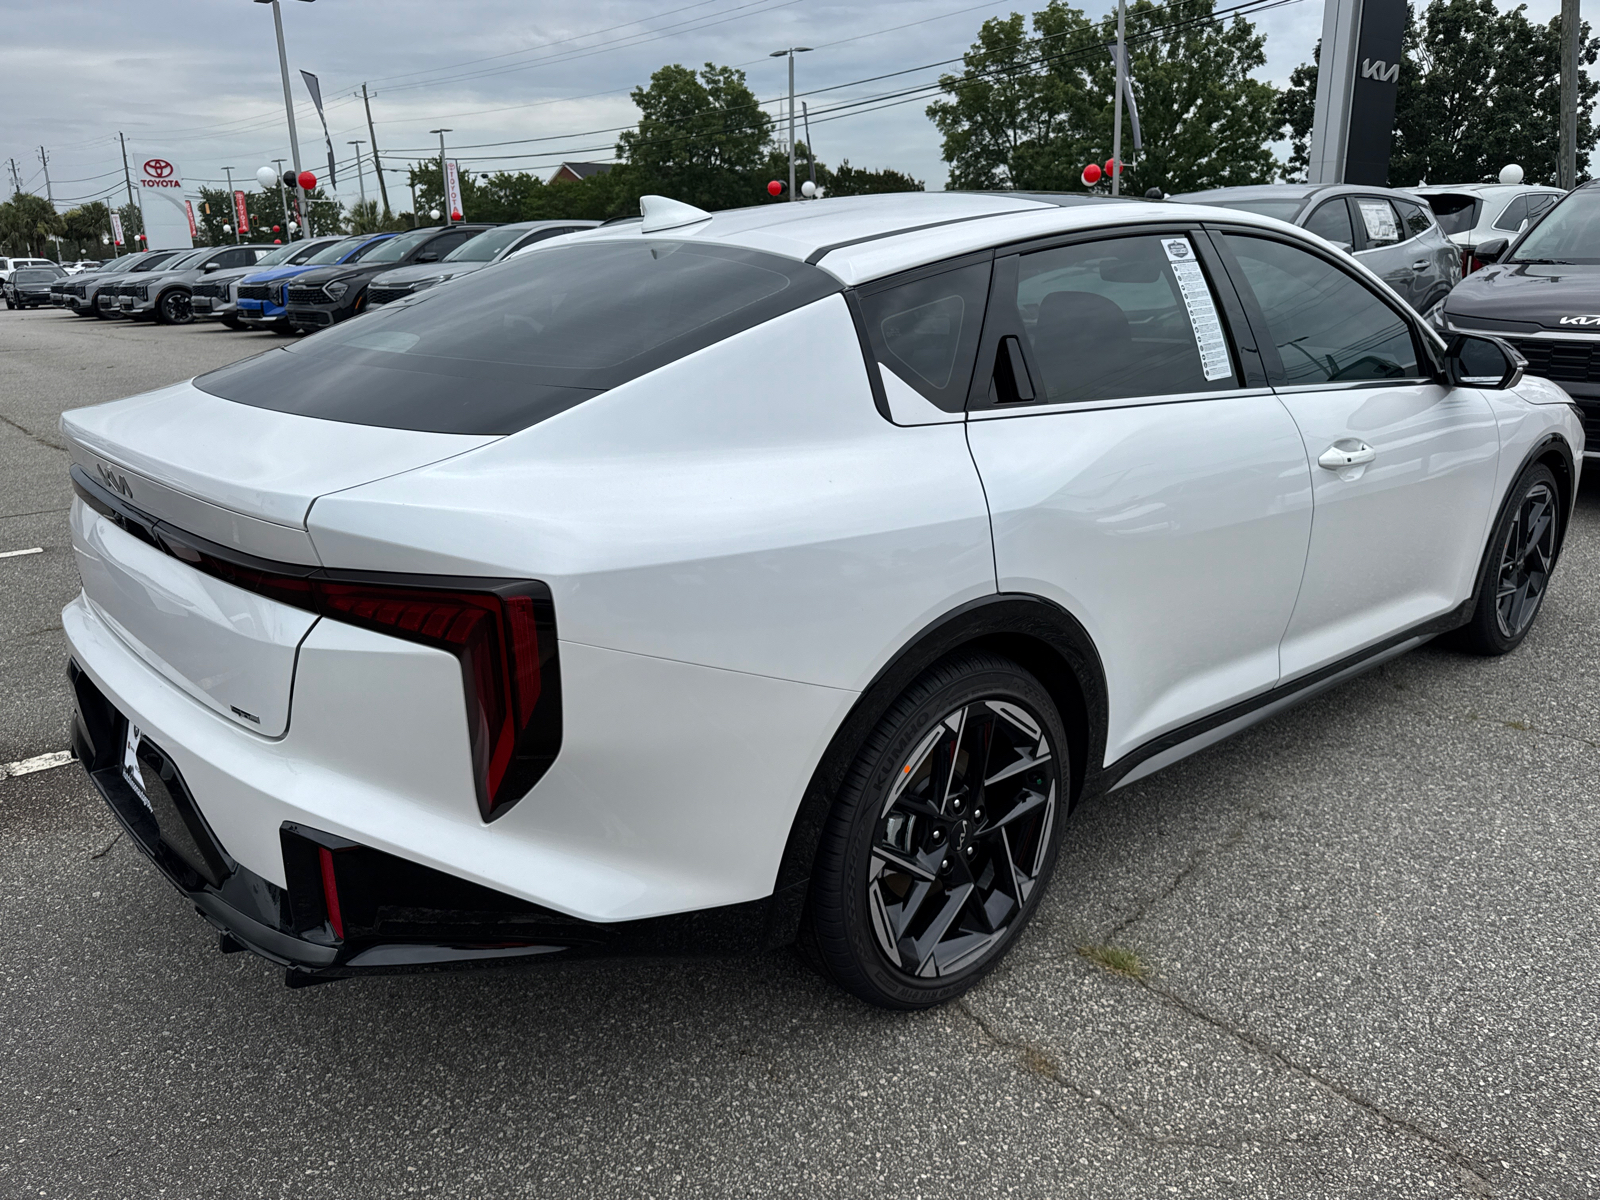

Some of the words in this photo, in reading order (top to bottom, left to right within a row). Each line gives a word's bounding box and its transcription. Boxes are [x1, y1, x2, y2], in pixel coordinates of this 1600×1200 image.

[140, 179, 181, 188] TOYOTA
[449, 171, 459, 213] TOYOTA
[239, 199, 248, 230] TOYOTA
[873, 712, 929, 791] KUMHO
